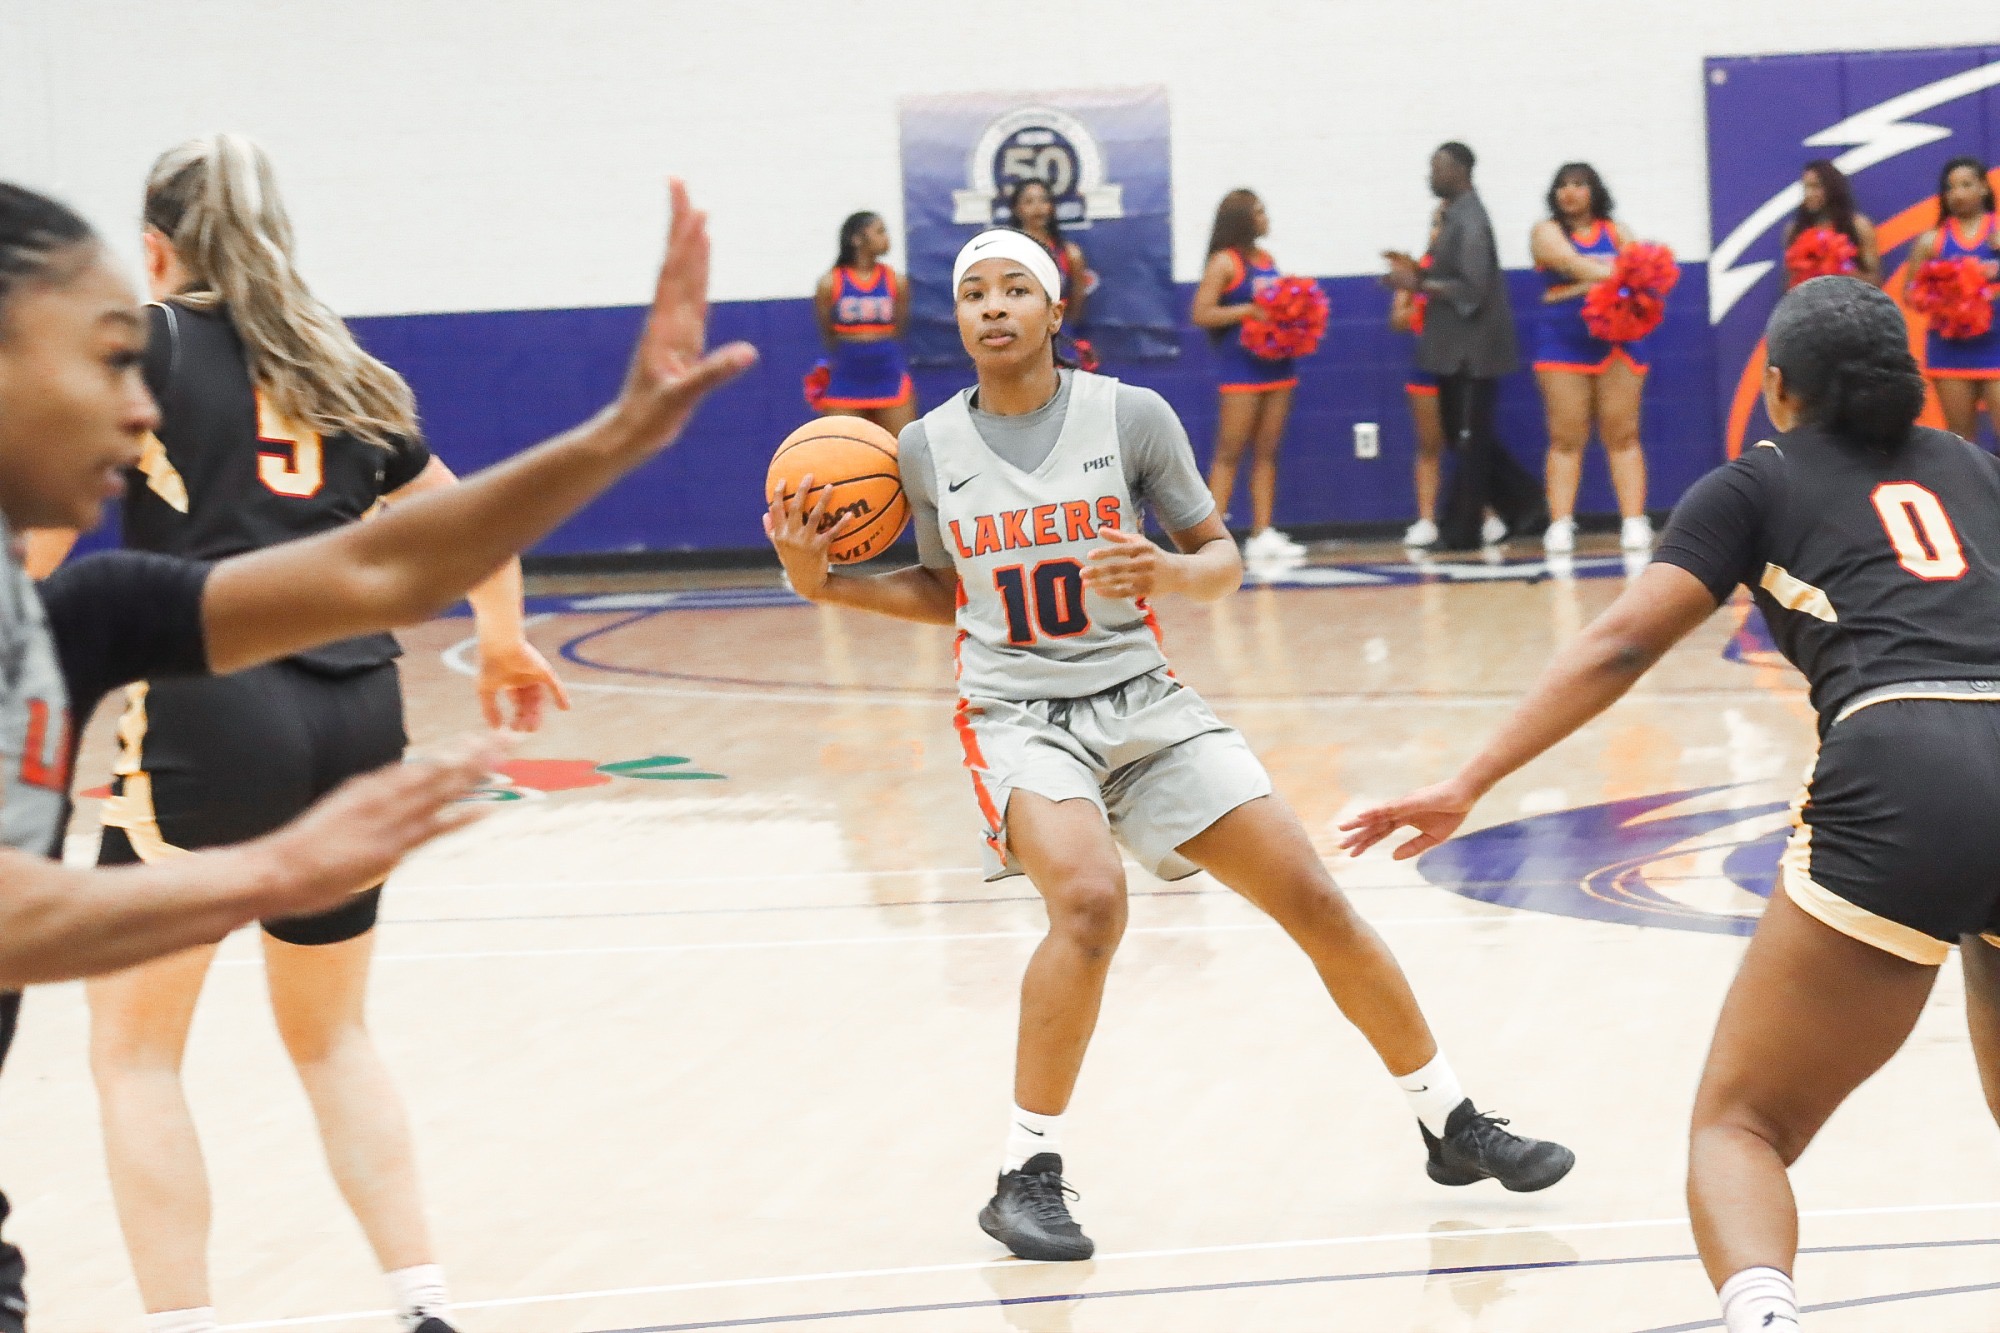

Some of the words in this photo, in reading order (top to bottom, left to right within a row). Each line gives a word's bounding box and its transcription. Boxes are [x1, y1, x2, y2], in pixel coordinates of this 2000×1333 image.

[1004, 145, 1072, 197] 50
[255, 384, 325, 499] 5
[1083, 455, 1115, 473] PBC
[828, 539, 871, 561] VO
[949, 495, 1120, 558] LAKERS
[1870, 481, 1969, 581] 0
[992, 557, 1092, 646] 10
